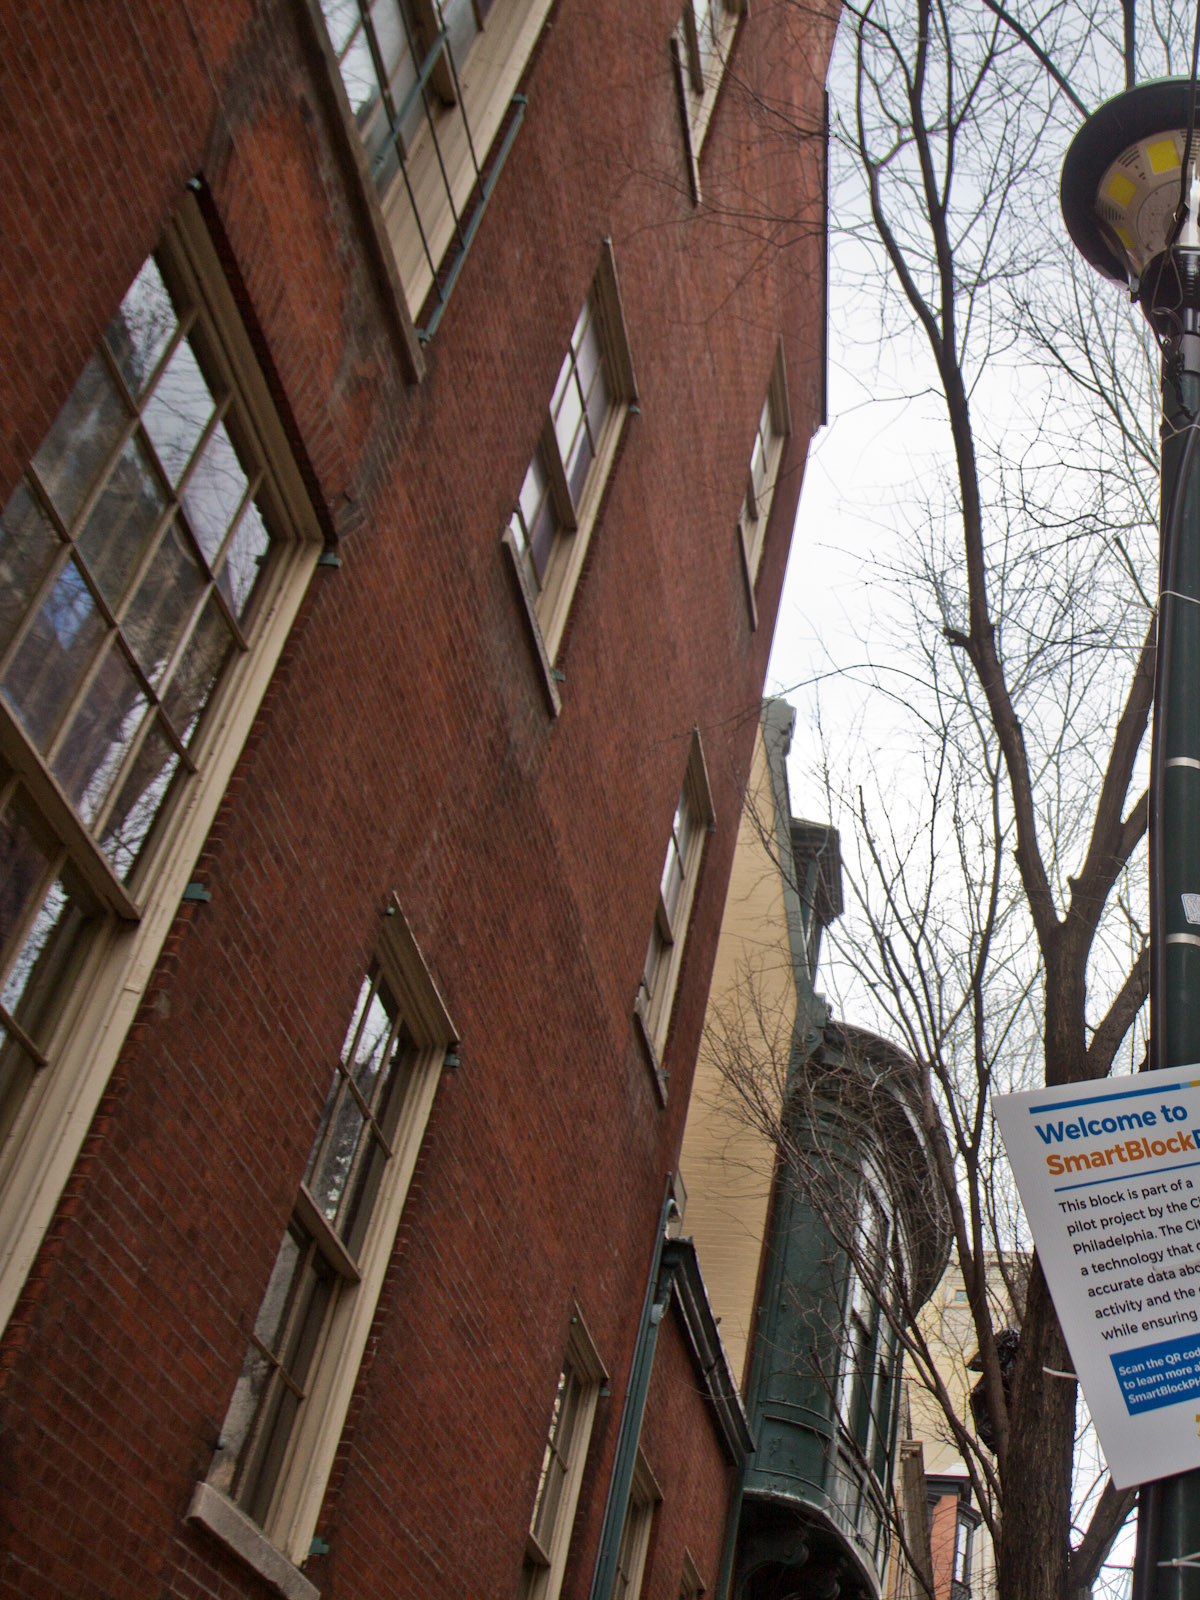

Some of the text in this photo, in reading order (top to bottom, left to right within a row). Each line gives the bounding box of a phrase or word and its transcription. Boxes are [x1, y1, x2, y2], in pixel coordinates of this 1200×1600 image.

[1034, 1105, 1188, 1144] Welcome to
[1058, 1179, 1193, 1213] This block is part of a
[1066, 1219, 1097, 1237] pilot
[1100, 1209, 1146, 1230] project
[1148, 1206, 1163, 1218] by
[1166, 1202, 1188, 1214] the
[1072, 1229, 1157, 1255] Philadelphia.
[1158, 1224, 1183, 1236] The
[1080, 1267, 1089, 1276] a
[1091, 1250, 1163, 1274] technology
[1166, 1243, 1194, 1257] that
[1088, 1277, 1144, 1298] accurate
[1147, 1270, 1176, 1284] data
[1094, 1300, 1142, 1319] activity
[1146, 1291, 1171, 1307] and
[1174, 1288, 1196, 1300] the
[1101, 1323, 1138, 1340] while
[1141, 1310, 1198, 1331] ensuring
[1118, 1364, 1145, 1376] Scan
[1146, 1358, 1165, 1369] the
[1165, 1353, 1182, 1365] QR
[1123, 1380, 1136, 1390] to
[1136, 1373, 1164, 1387] learn
[1165, 1366, 1193, 1379] more
